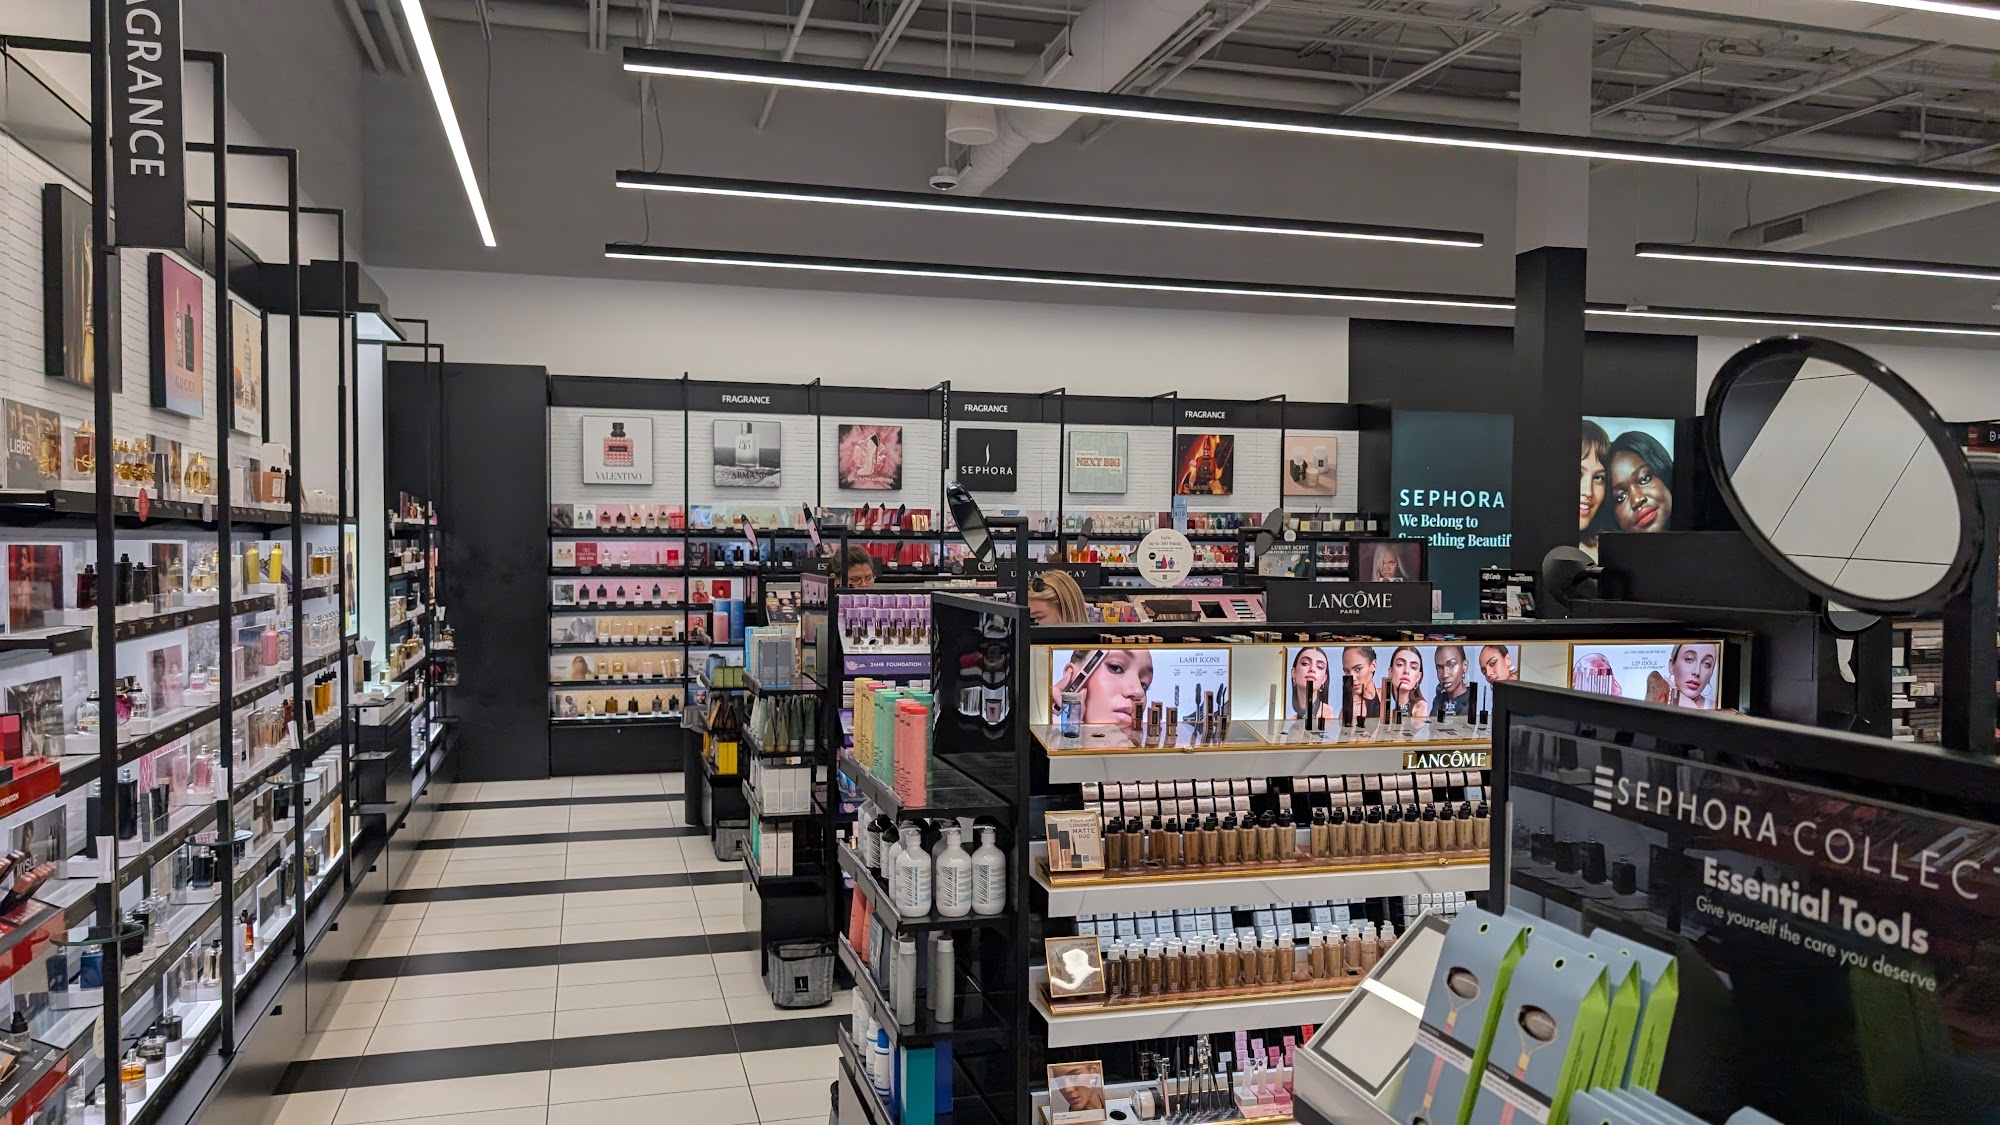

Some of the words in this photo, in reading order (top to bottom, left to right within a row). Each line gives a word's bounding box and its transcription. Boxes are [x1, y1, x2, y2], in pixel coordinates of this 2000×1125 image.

[175, 376, 195, 393] GUCCI
[722, 394, 771, 405] FRAGRANCE
[964, 403, 1008, 413] FRAGRANCE
[1185, 410, 1226, 419] FRAGRANCE
[9, 437, 32, 456] LIBRE
[961, 465, 1013, 475] SEPHORA
[1076, 457, 1102, 467] NEXT
[1103, 457, 1121, 467] BIG
[595, 471, 642, 480] VALENTINO
[1399, 489, 1505, 508] SEPHORA
[1398, 513, 1418, 527] We
[1420, 513, 1464, 530] Belong
[1466, 515, 1479, 528] to
[1398, 532, 1466, 549] ething
[1467, 533, 1512, 548] Beautif
[1010, 570, 1047, 578] UBAN
[1307, 590, 1393, 609] LANCÔME
[1407, 750, 1487, 769] LANCÔME
[1616, 776, 1777, 847] SEPHORA
[1793, 820, 2000, 900] COLLEC
[1703, 855, 1830, 924] Essential
[1838, 896, 1930, 955] Tools
[1696, 894, 1724, 919] Give
[1727, 908, 1777, 937] yourself
[1779, 921, 1801, 945] the
[1803, 936, 1836, 958] care
[1839, 949, 1869, 968] you
[1872, 954, 1937, 993] deserve
